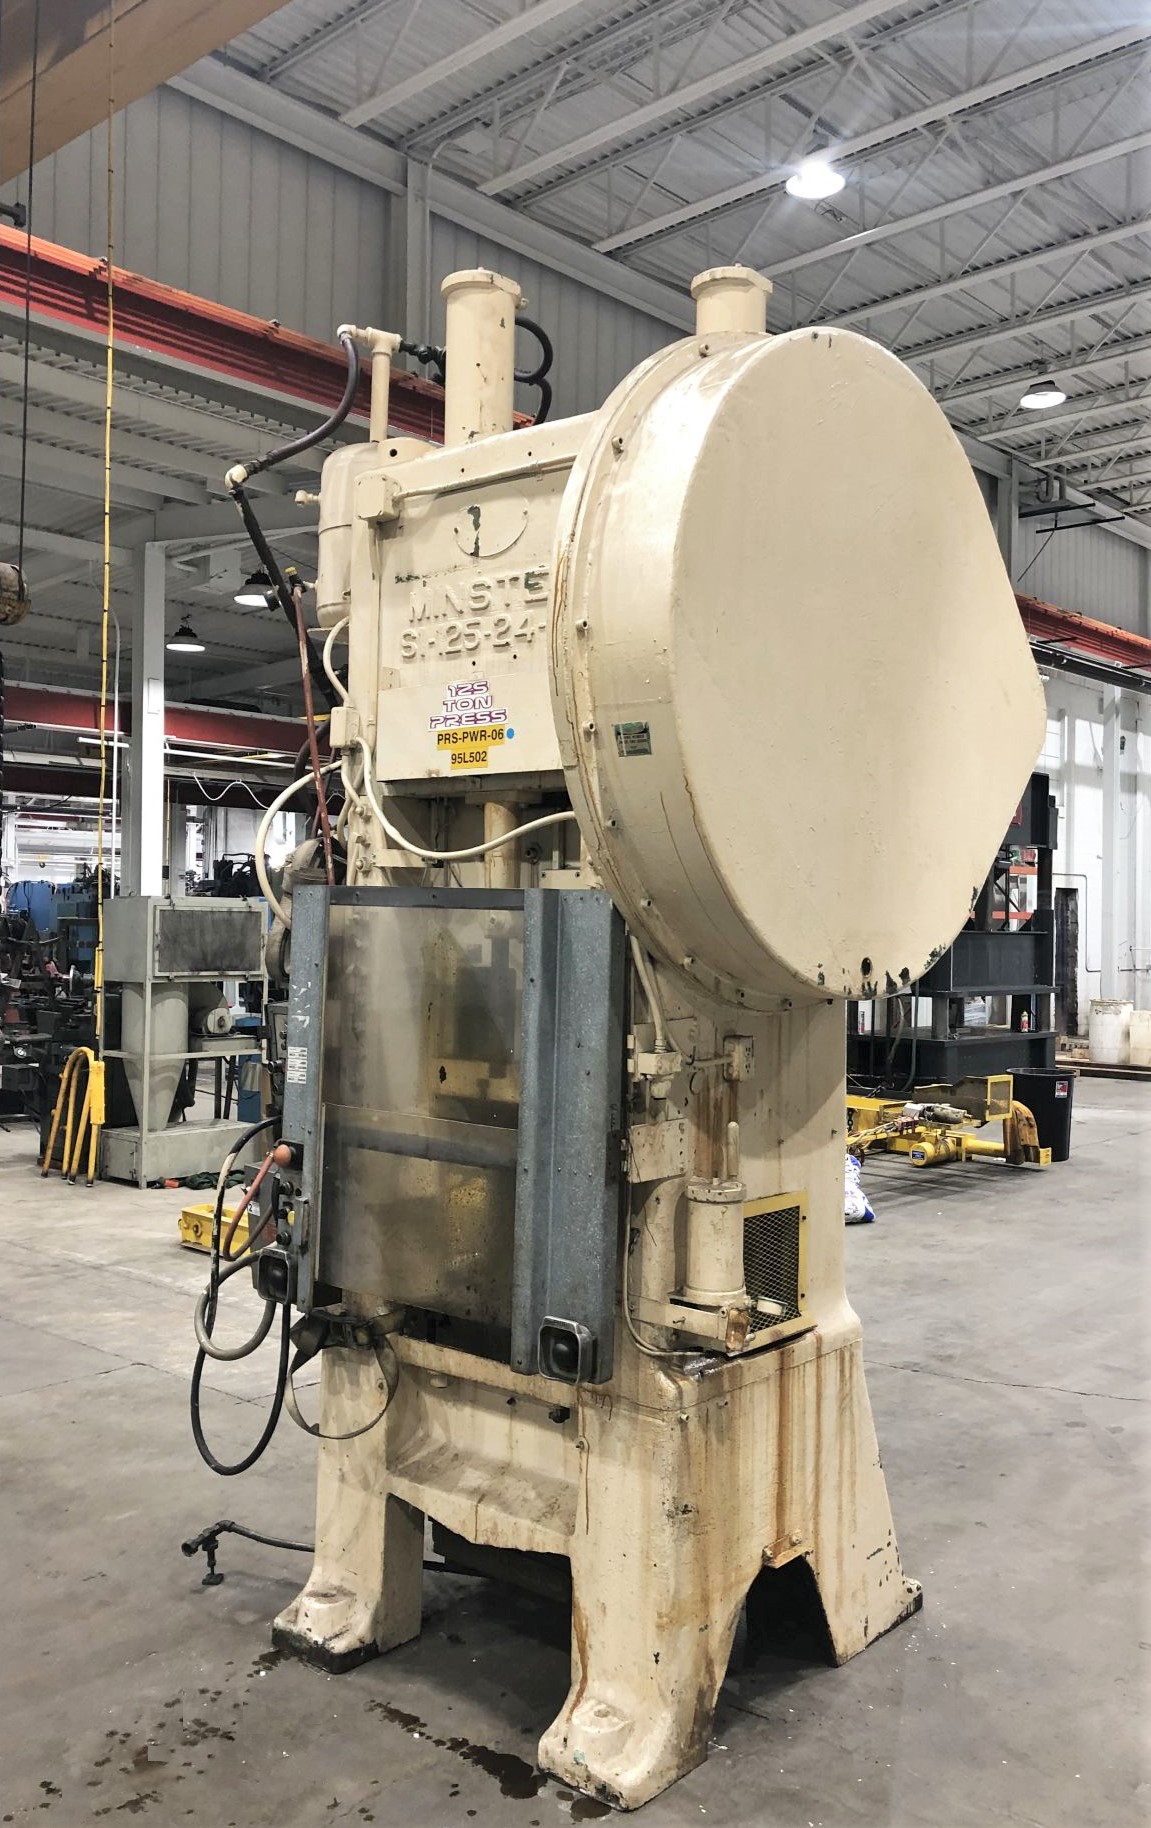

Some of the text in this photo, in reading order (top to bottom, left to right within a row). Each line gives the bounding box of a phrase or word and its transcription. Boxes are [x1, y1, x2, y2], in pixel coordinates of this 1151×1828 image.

[448, 681, 489, 697] 125
[443, 695, 493, 712] TON
[430, 709, 507, 729] PRESS
[437, 728, 504, 745] PRS-PWR-06
[451, 750, 487, 764] 95L502
